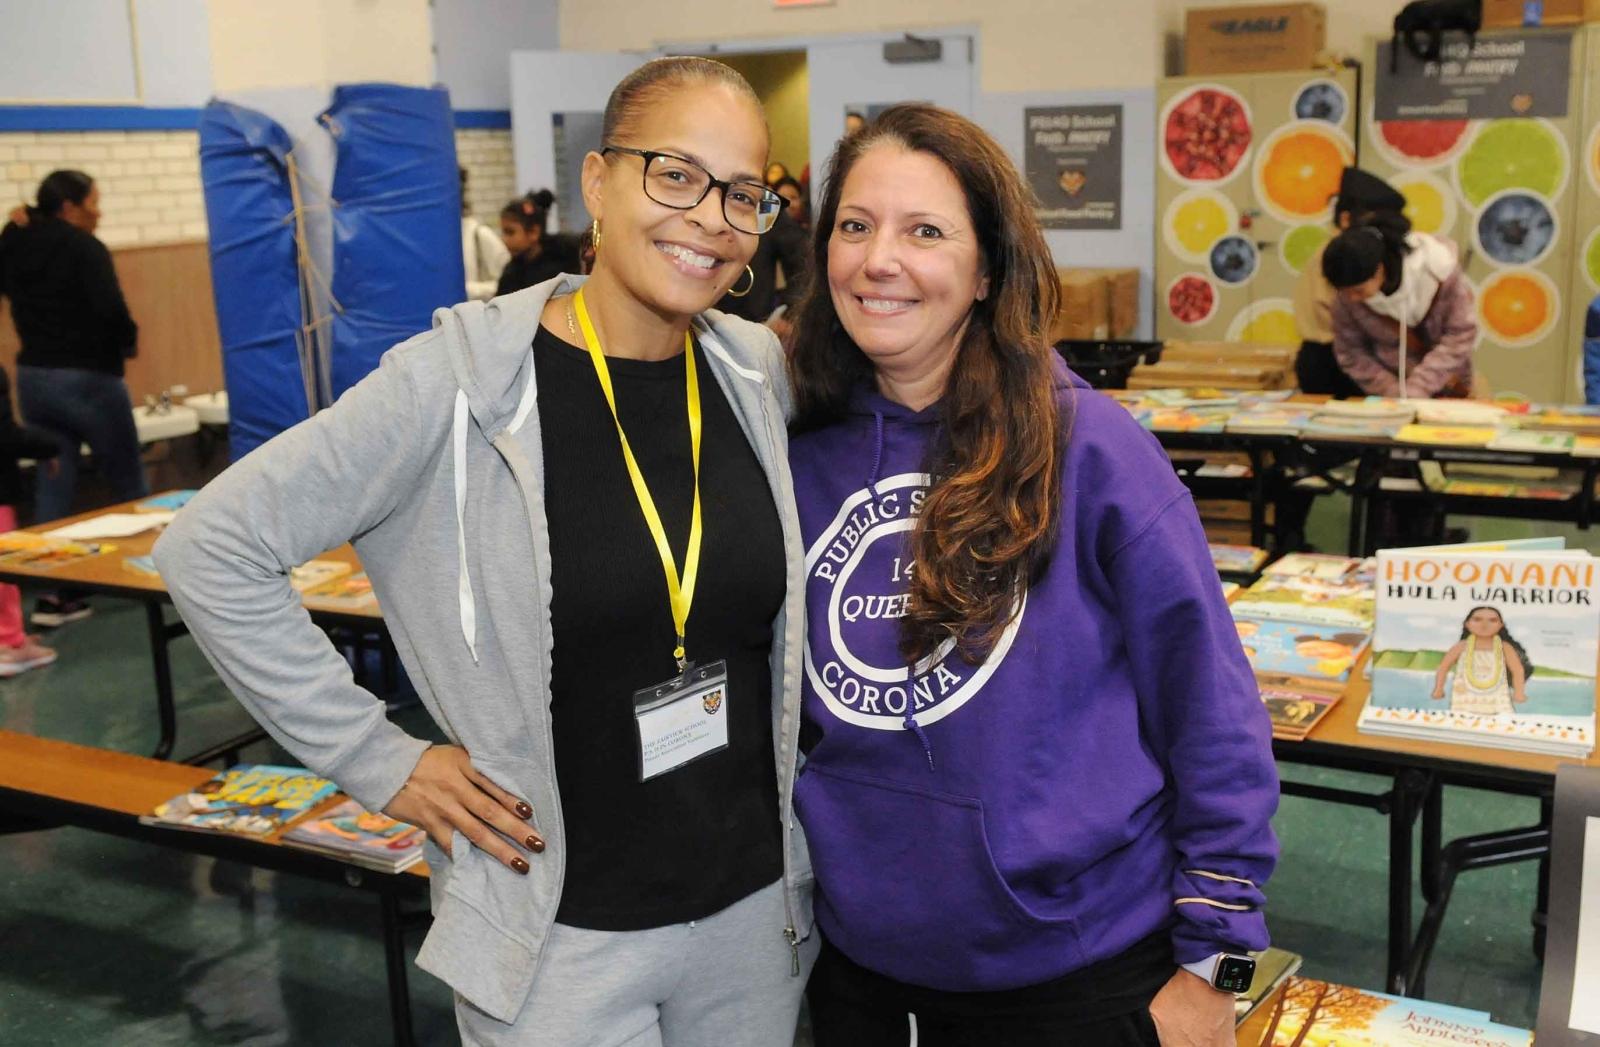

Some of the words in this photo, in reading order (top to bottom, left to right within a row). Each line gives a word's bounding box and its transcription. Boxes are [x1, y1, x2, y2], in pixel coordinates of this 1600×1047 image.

[814, 494, 900, 584] PUBLIC
[842, 593, 914, 623] QUEE
[1388, 584, 1457, 601] HULA
[1471, 587, 1591, 606] WARRIOR
[822, 660, 962, 714] CORONA
